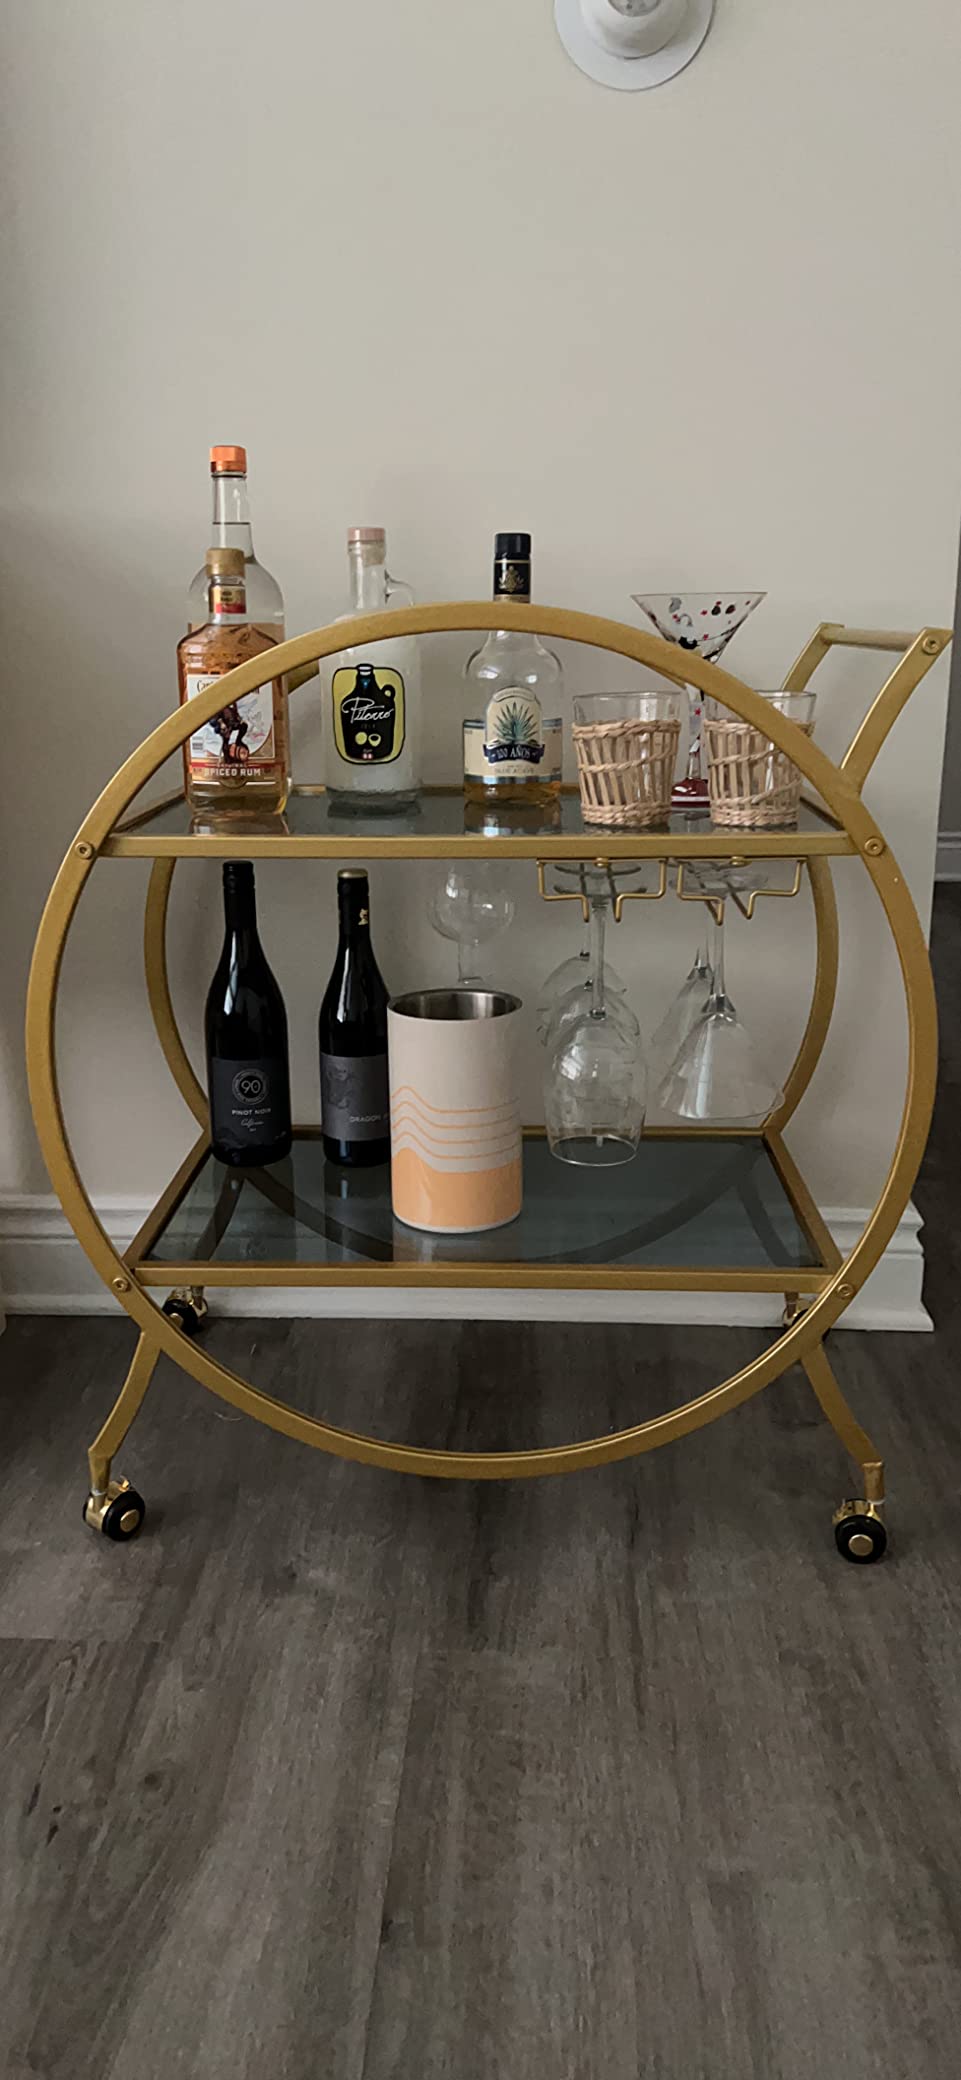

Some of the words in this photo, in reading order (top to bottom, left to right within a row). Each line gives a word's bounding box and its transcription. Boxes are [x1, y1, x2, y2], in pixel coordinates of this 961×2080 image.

[203, 767, 238, 777] SPICED
[240, 767, 262, 777] RUM
[241, 1079, 261, 1095] 90
[231, 1108, 253, 1116] PINOT
[254, 1107, 272, 1115] NOIR
